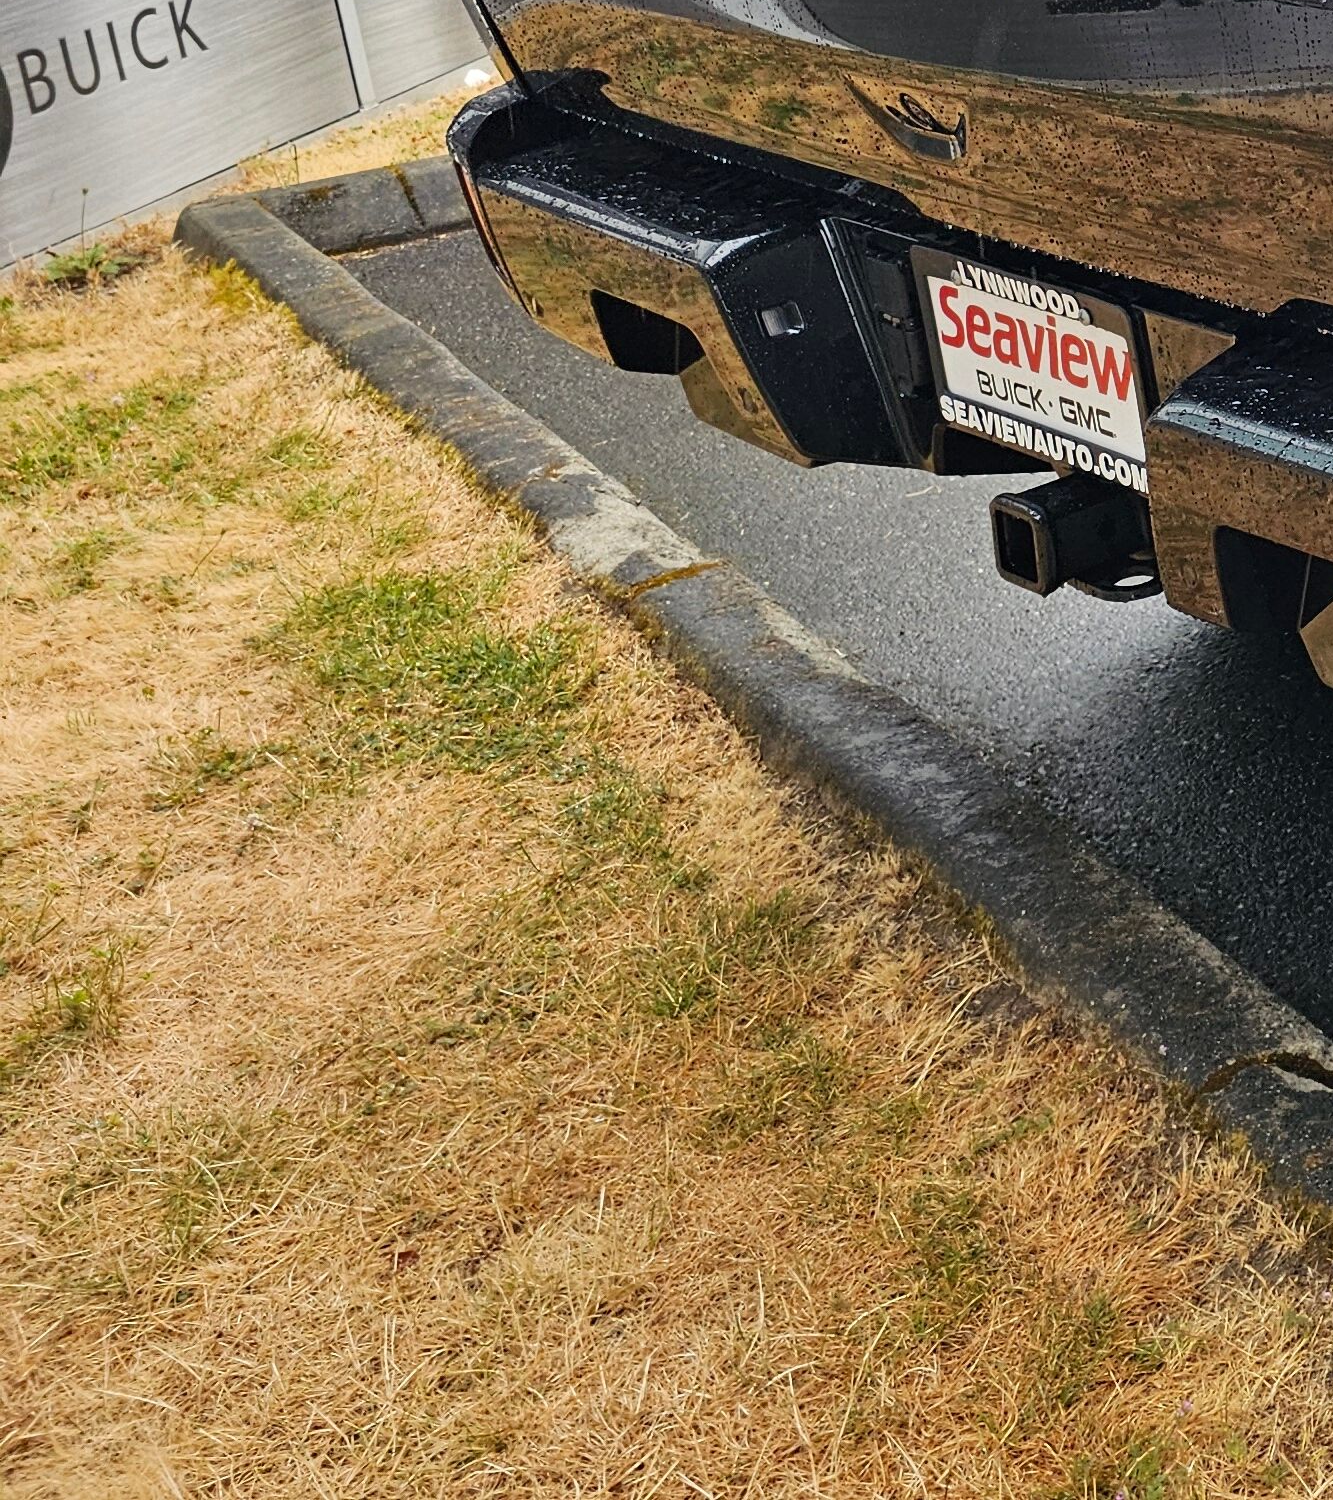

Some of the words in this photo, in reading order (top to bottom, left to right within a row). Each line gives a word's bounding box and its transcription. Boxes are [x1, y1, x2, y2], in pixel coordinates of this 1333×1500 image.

[956, 260, 1080, 319] LYNNWOOD
[938, 285, 1134, 403] Seaview
[939, 395, 1150, 495] SEAVIEWAUTO.COM
